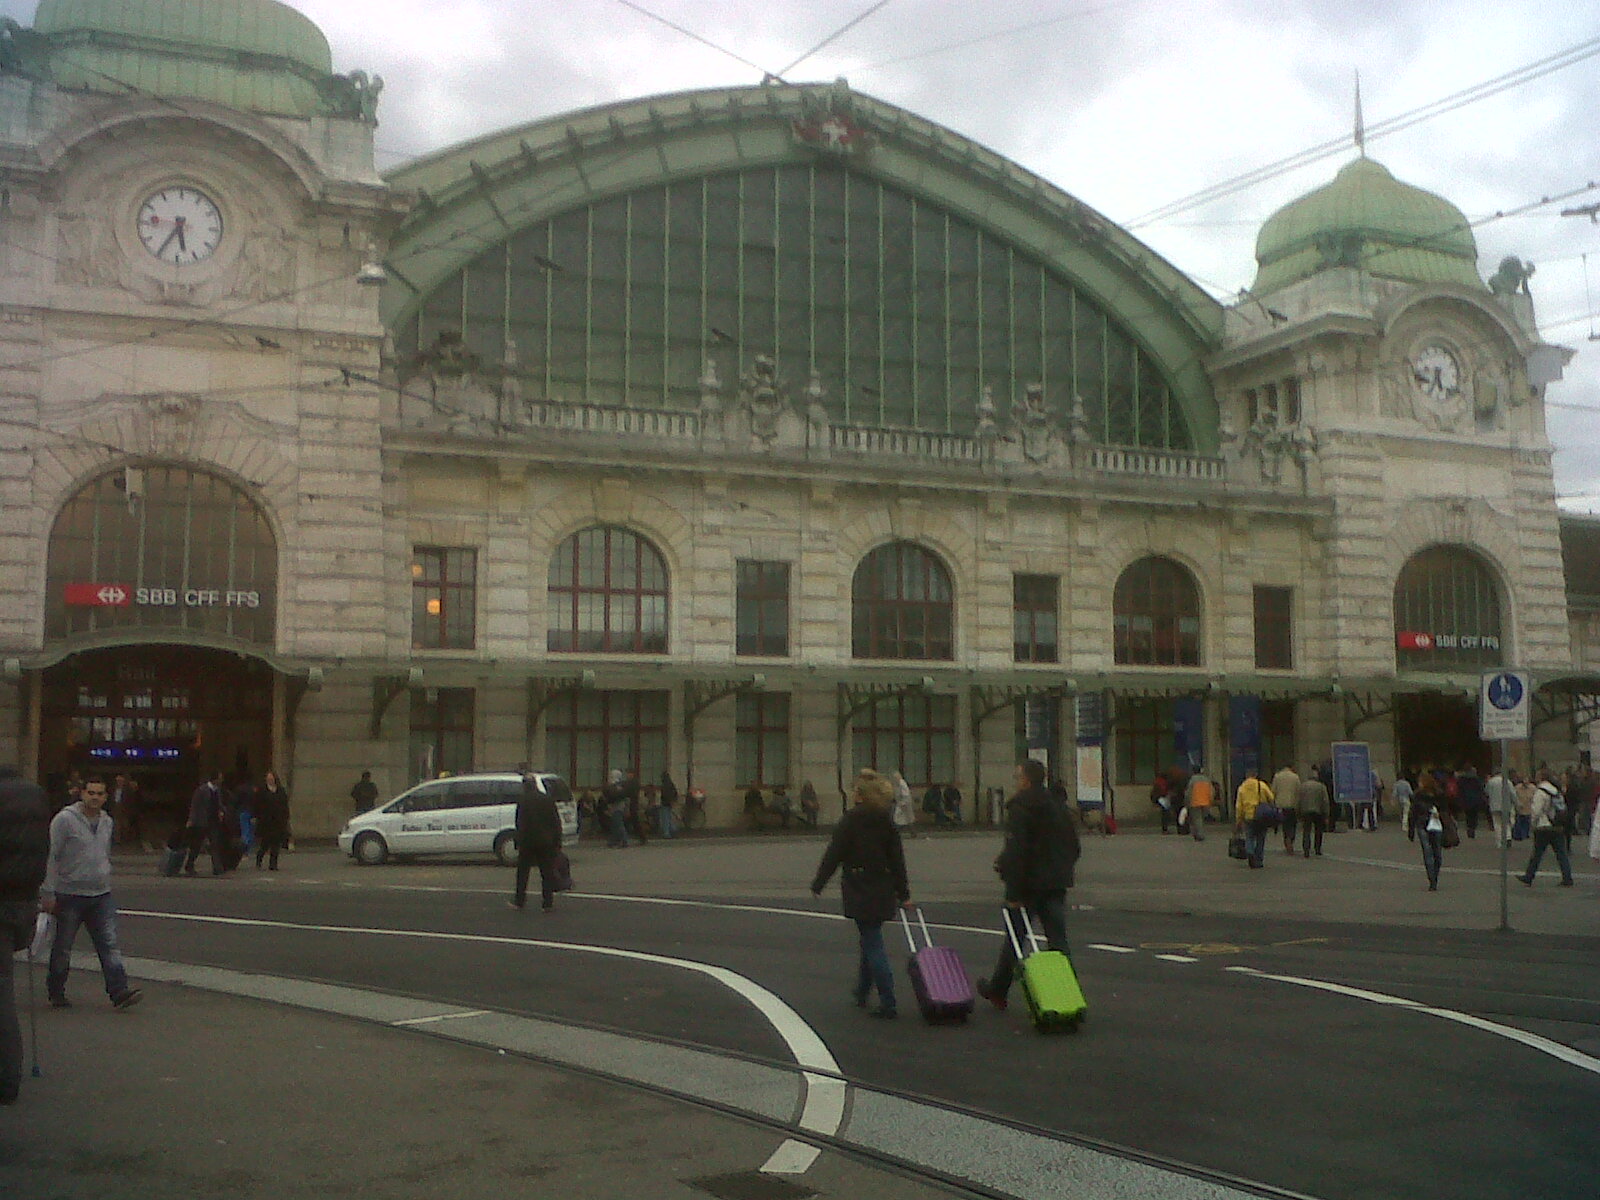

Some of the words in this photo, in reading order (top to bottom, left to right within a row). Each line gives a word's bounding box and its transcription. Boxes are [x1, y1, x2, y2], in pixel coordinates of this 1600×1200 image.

[136, 587, 177, 605] SBB
[184, 588, 220, 607] CFF
[225, 590, 260, 608] FFS
[1435, 634, 1457, 648] SBB
[1460, 635, 1478, 649] CFF
